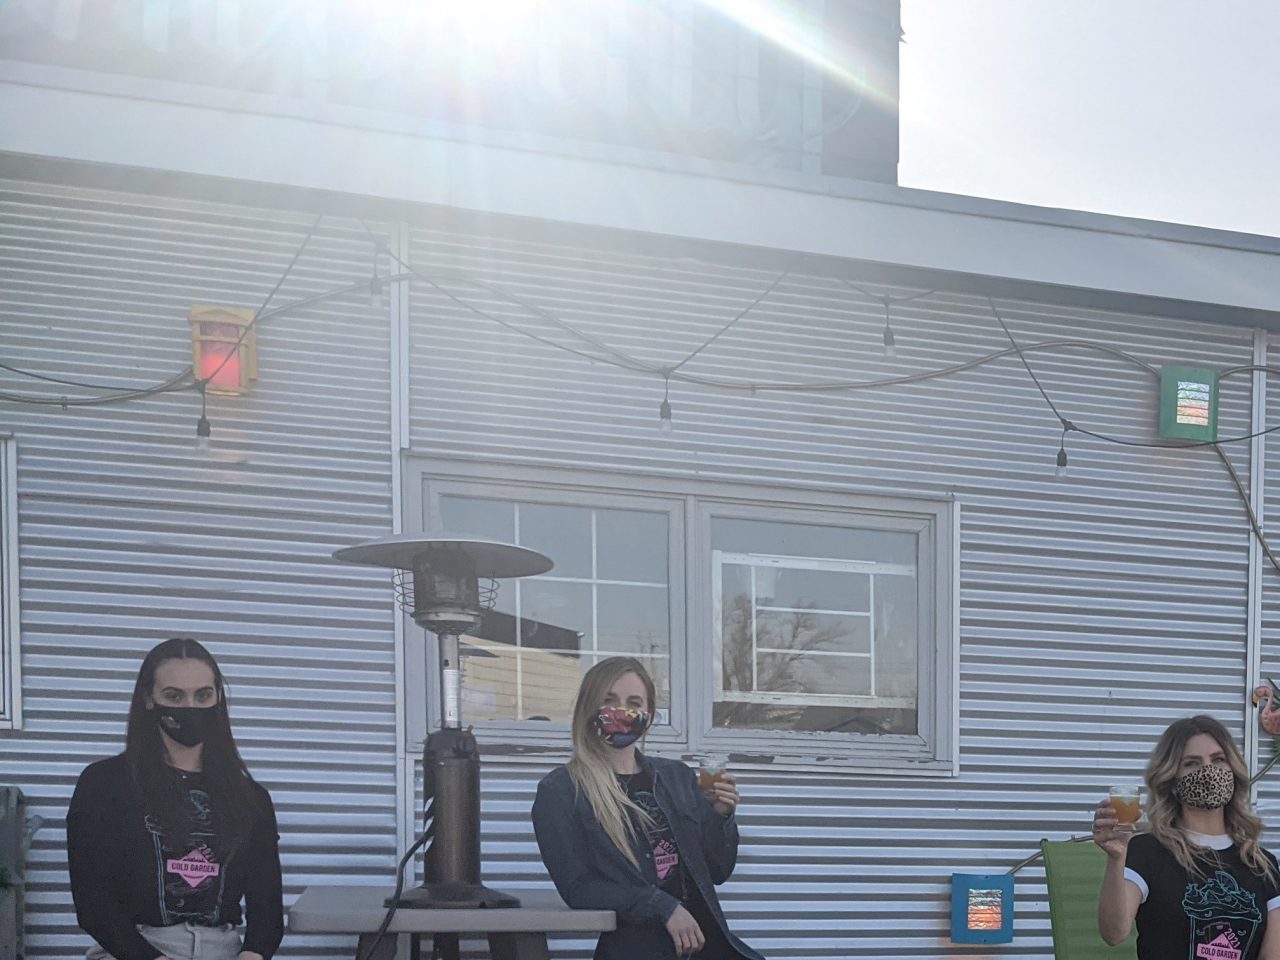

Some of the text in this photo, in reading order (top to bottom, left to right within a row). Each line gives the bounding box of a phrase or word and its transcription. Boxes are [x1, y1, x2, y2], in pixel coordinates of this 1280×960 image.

[171, 862, 215, 873] COLD GARDEN
[1224, 928, 1241, 948] 2021
[1200, 946, 1238, 960] COLD GARDEN
